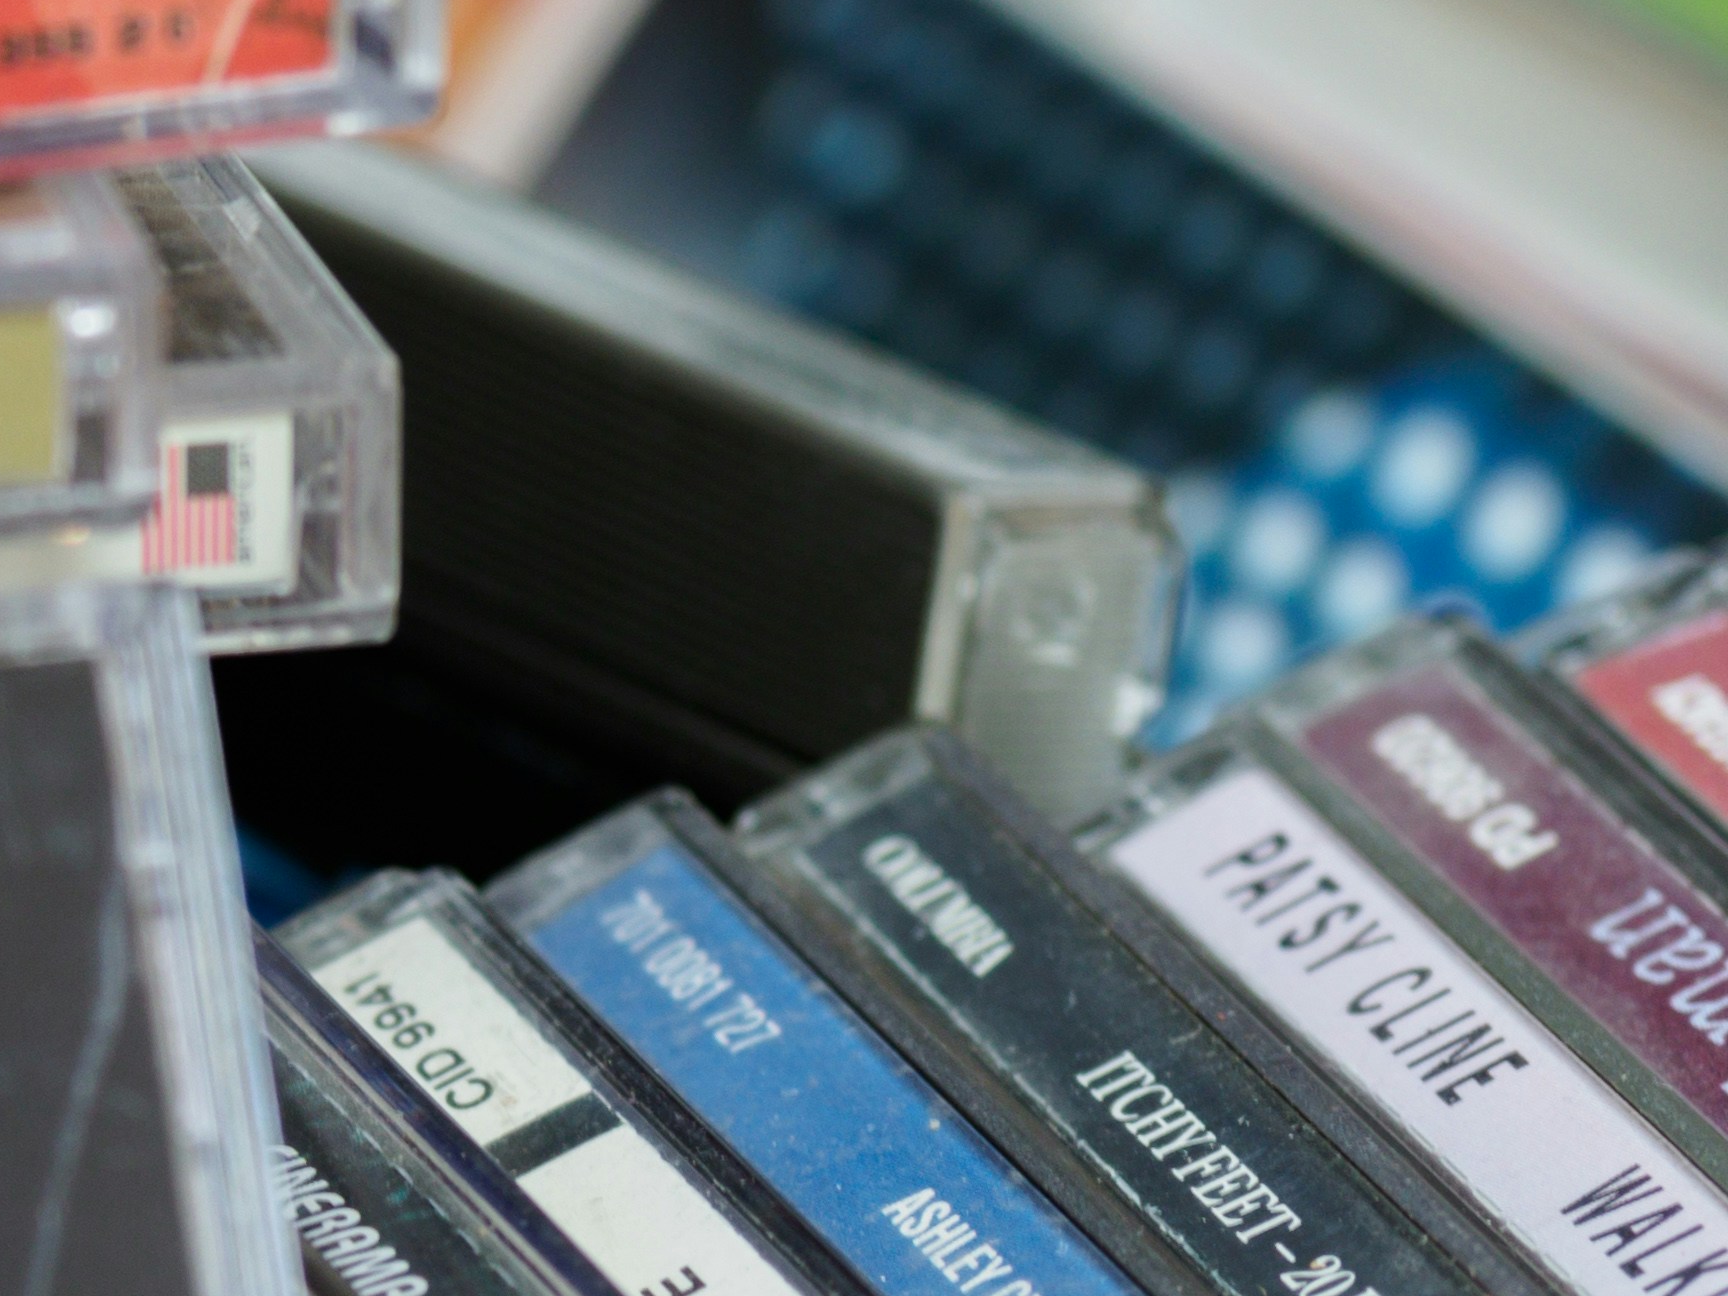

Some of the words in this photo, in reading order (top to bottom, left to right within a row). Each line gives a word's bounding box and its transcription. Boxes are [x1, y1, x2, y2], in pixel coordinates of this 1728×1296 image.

[346, 973, 435, 1050] 9941
[1204, 832, 1395, 974] PATSY
[1346, 966, 1529, 1106] CLINE
[417, 1048, 493, 1110] CID
[1076, 1050, 1214, 1181] ITCHY
[1192, 1143, 1302, 1244] FEET
[882, 1188, 1012, 1294] ASHLEY
